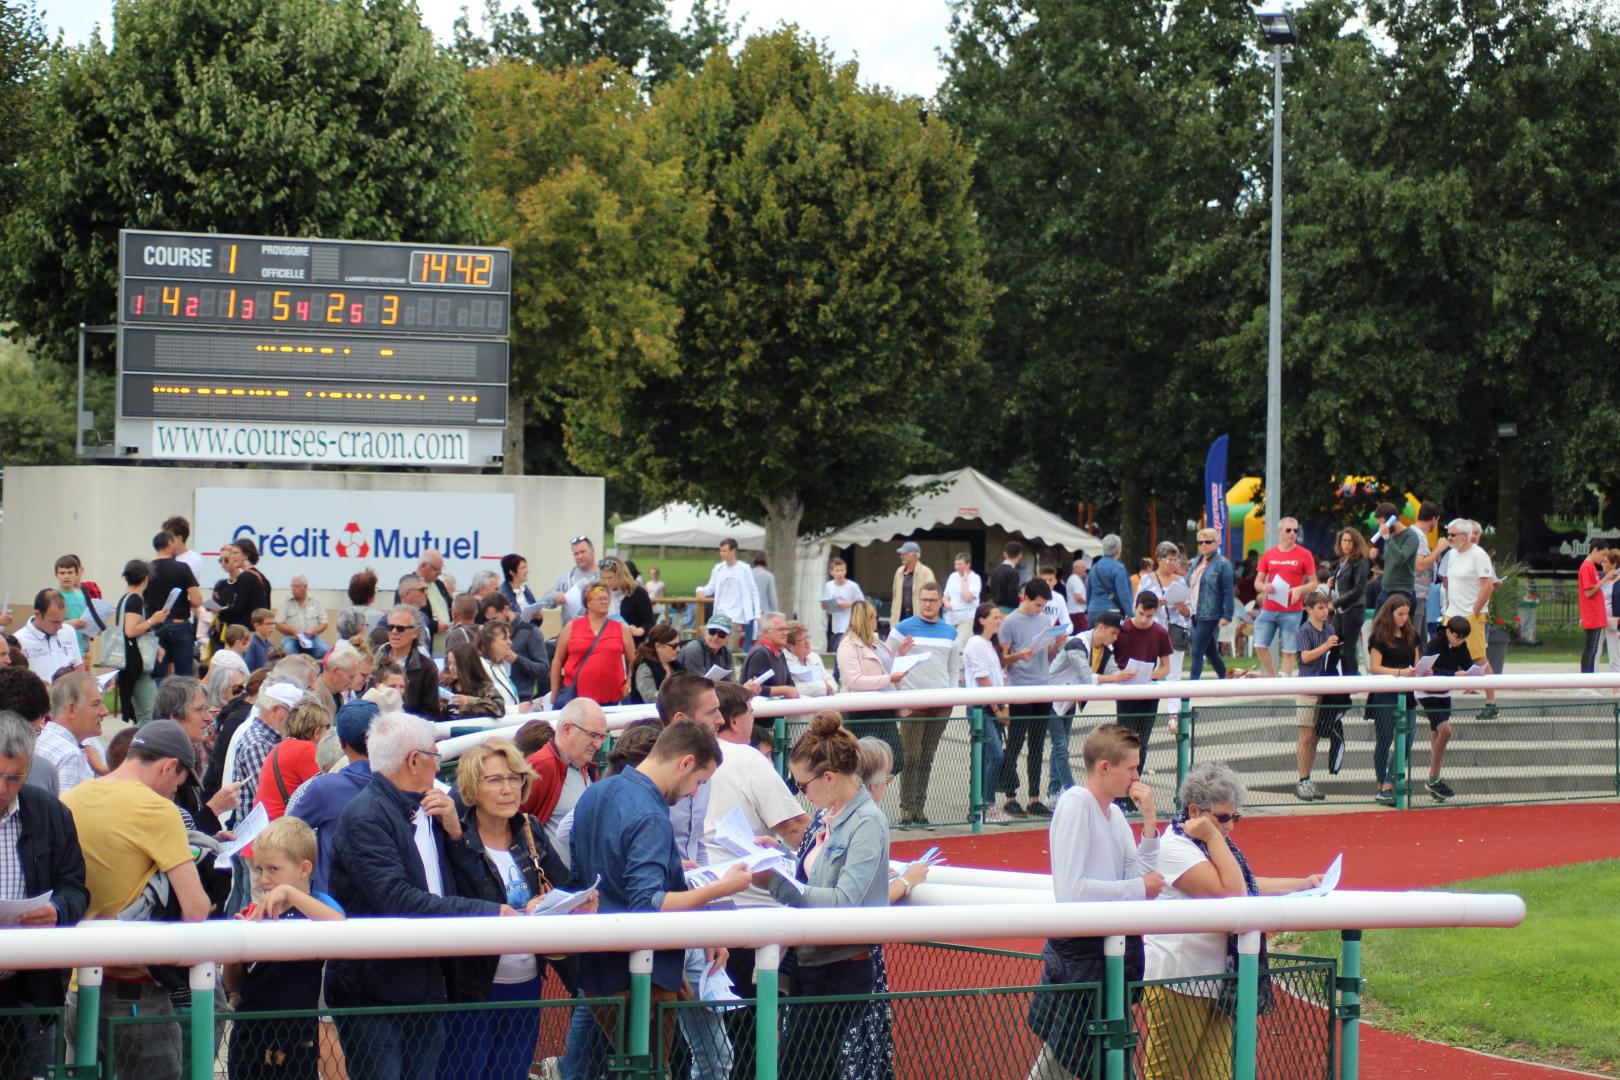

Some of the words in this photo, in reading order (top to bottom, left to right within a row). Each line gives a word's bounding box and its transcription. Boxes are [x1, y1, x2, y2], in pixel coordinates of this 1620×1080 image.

[143, 245, 213, 268] COURSE
[228, 244, 237, 275] 1
[260, 244, 310, 257] PROVISOIRE
[260, 267, 305, 279] OFFICIELLE
[162, 286, 181, 317] 4
[185, 296, 200, 317] 2
[228, 288, 237, 319] 1
[240, 299, 255, 320] 3
[272, 290, 291, 321] 5
[296, 301, 310, 321] 4
[326, 292, 345, 323] 2
[380, 294, 399, 325] 3
[156, 424, 466, 462] www.courses-craon.com
[373, 528, 479, 560] Mutuel
